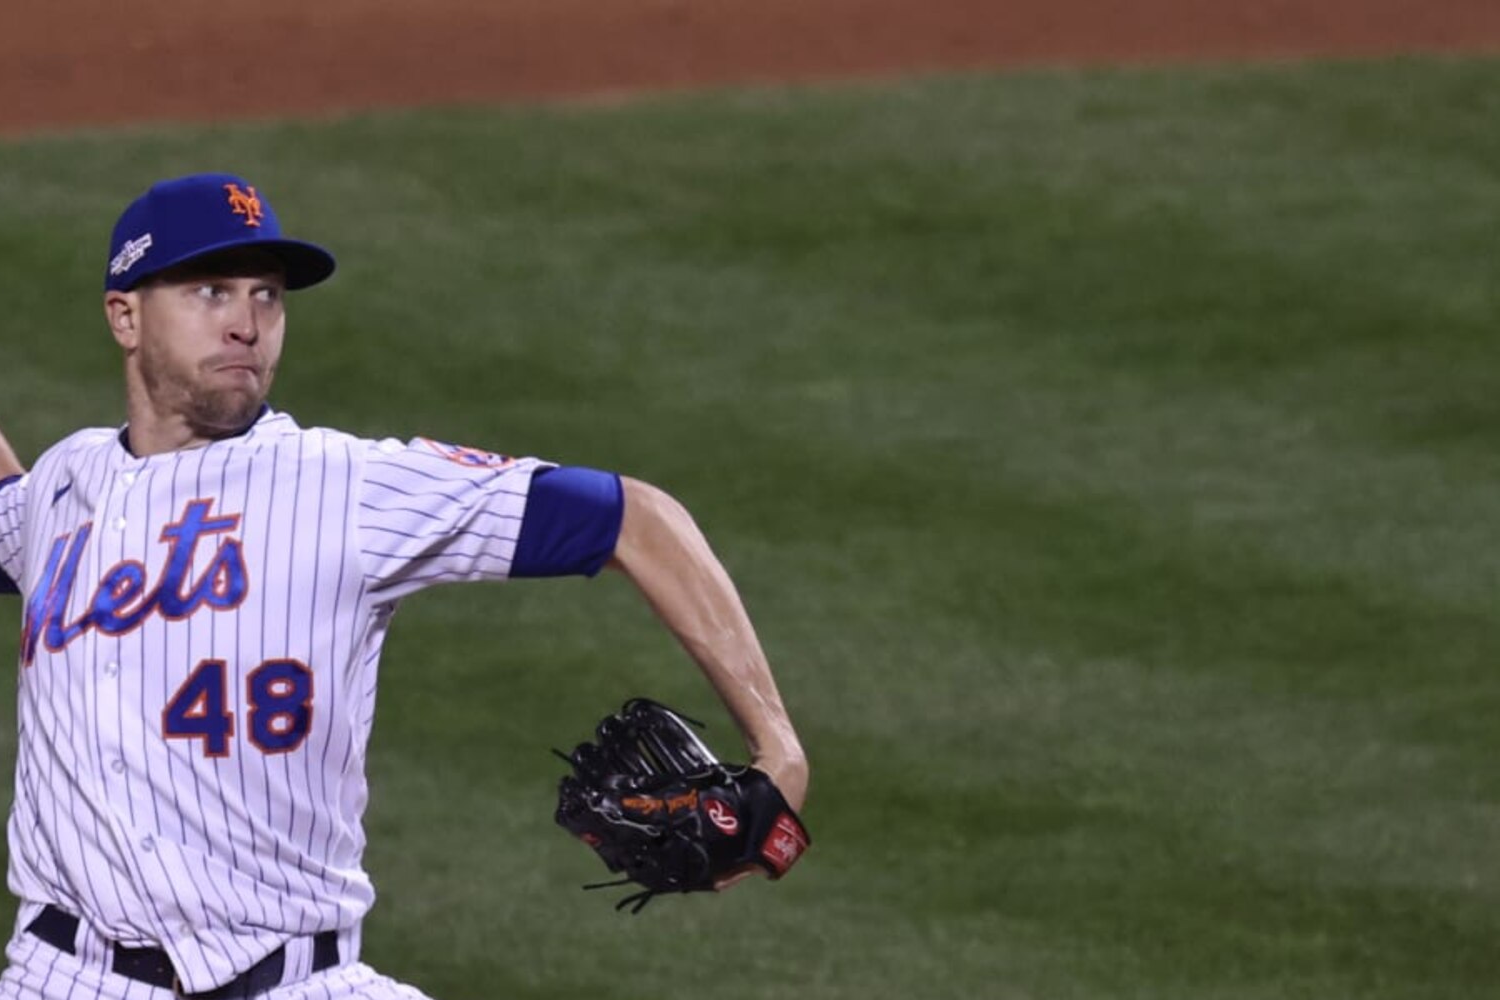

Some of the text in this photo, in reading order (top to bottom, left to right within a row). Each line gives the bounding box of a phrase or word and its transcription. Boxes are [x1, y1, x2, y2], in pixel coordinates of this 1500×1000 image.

[223, 183, 264, 228] NY
[20, 497, 249, 668] Mets
[161, 657, 315, 759] 48
